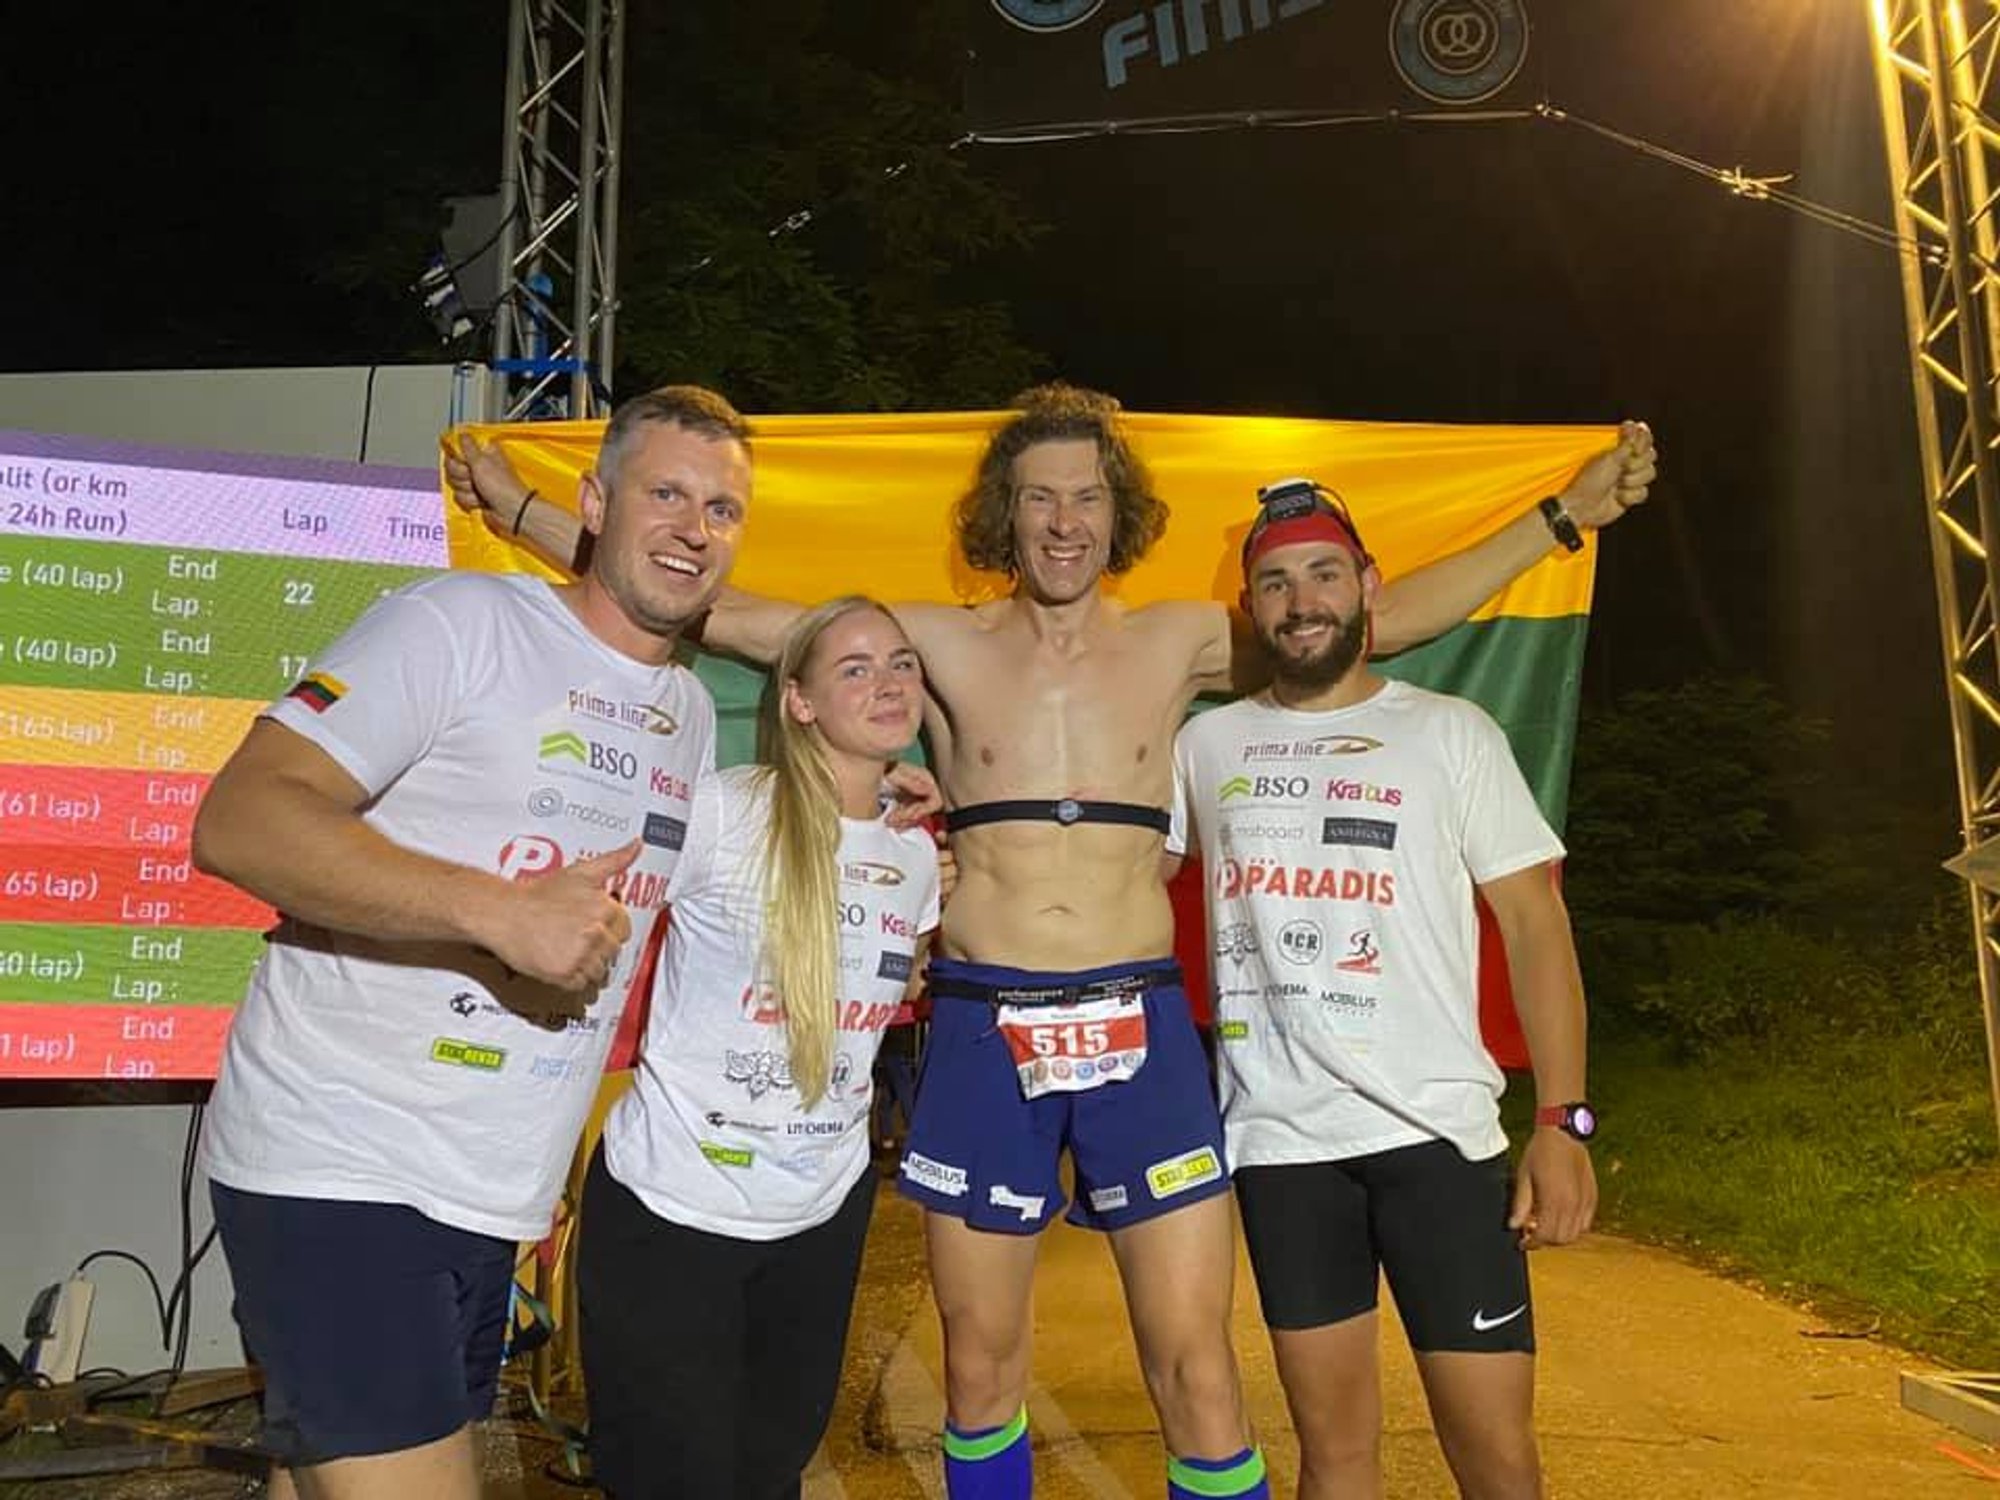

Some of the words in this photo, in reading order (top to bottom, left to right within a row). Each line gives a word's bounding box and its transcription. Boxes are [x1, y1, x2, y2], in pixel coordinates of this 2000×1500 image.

[42, 466, 80, 494] (or
[89, 473, 127, 497] km
[8, 503, 56, 528] 24h
[65, 507, 127, 536] Run)
[283, 508, 328, 533] Lap
[388, 517, 444, 542] Time
[23, 560, 65, 587] (40
[72, 566, 123, 597] lap)
[169, 555, 217, 580] End
[152, 589, 199, 619] Lap
[284, 581, 314, 605] 22
[15, 637, 58, 664] (40
[64, 641, 117, 670] lap)
[162, 629, 210, 654] End
[145, 665, 193, 696] Lap
[153, 705, 203, 729] End
[568, 689, 616, 719] prima
[620, 702, 649, 728] line
[138, 738, 185, 767] Lap
[589, 740, 637, 780] BSO
[1243, 741, 1289, 764] prima
[1292, 740, 1326, 756] line
[147, 780, 197, 806] End
[1253, 775, 1310, 799] BSO
[48, 793, 100, 826] lap)
[130, 815, 178, 846] Lap
[140, 856, 190, 883] End
[1246, 864, 1395, 905] PARADIS
[44, 871, 98, 902] lap)
[121, 893, 171, 926] Lap
[131, 935, 183, 961] End
[31, 950, 84, 983] lap)
[113, 973, 162, 1004] Lap
[123, 1015, 175, 1041] End
[1031, 1023, 1110, 1057] 515
[21, 1032, 76, 1064] lap)
[104, 1053, 155, 1079] Lap
